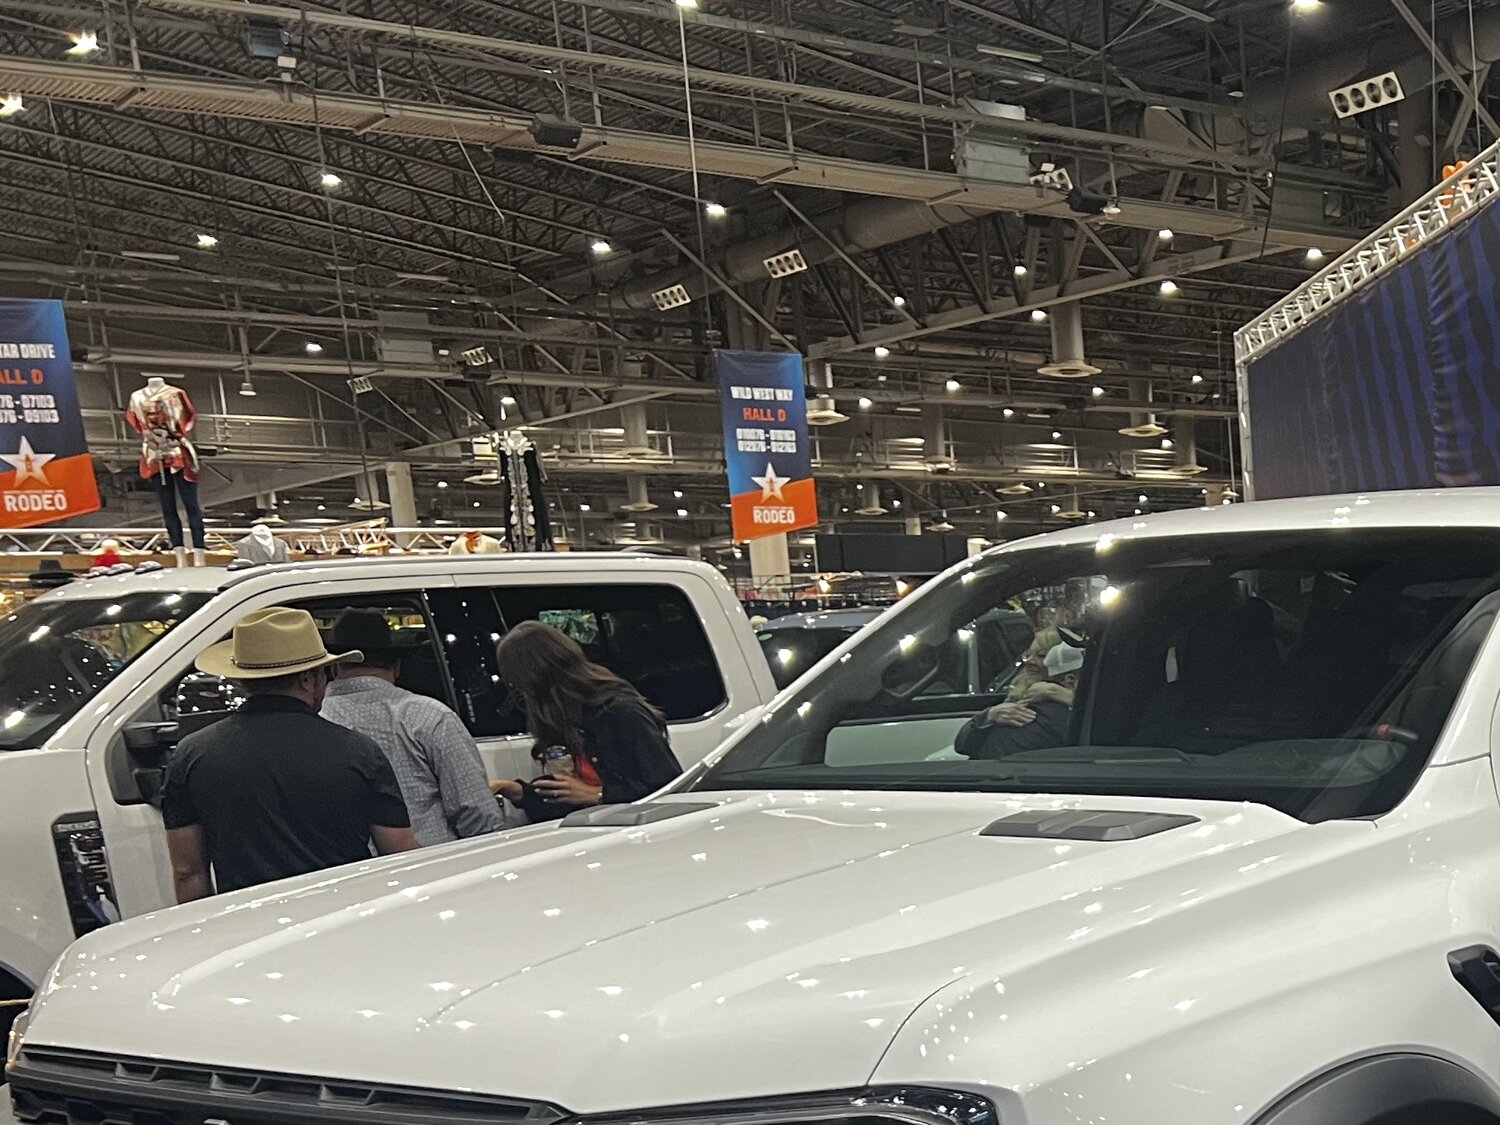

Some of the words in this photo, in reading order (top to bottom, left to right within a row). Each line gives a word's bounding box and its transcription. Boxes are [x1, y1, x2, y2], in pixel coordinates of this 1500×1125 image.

[19, 343, 56, 358] DRIVE
[31, 368, 44, 385] D
[743, 407, 775, 420] HALL
[777, 409, 786, 421] D
[4, 493, 68, 512] RODEO
[753, 509, 795, 524] RODEO
